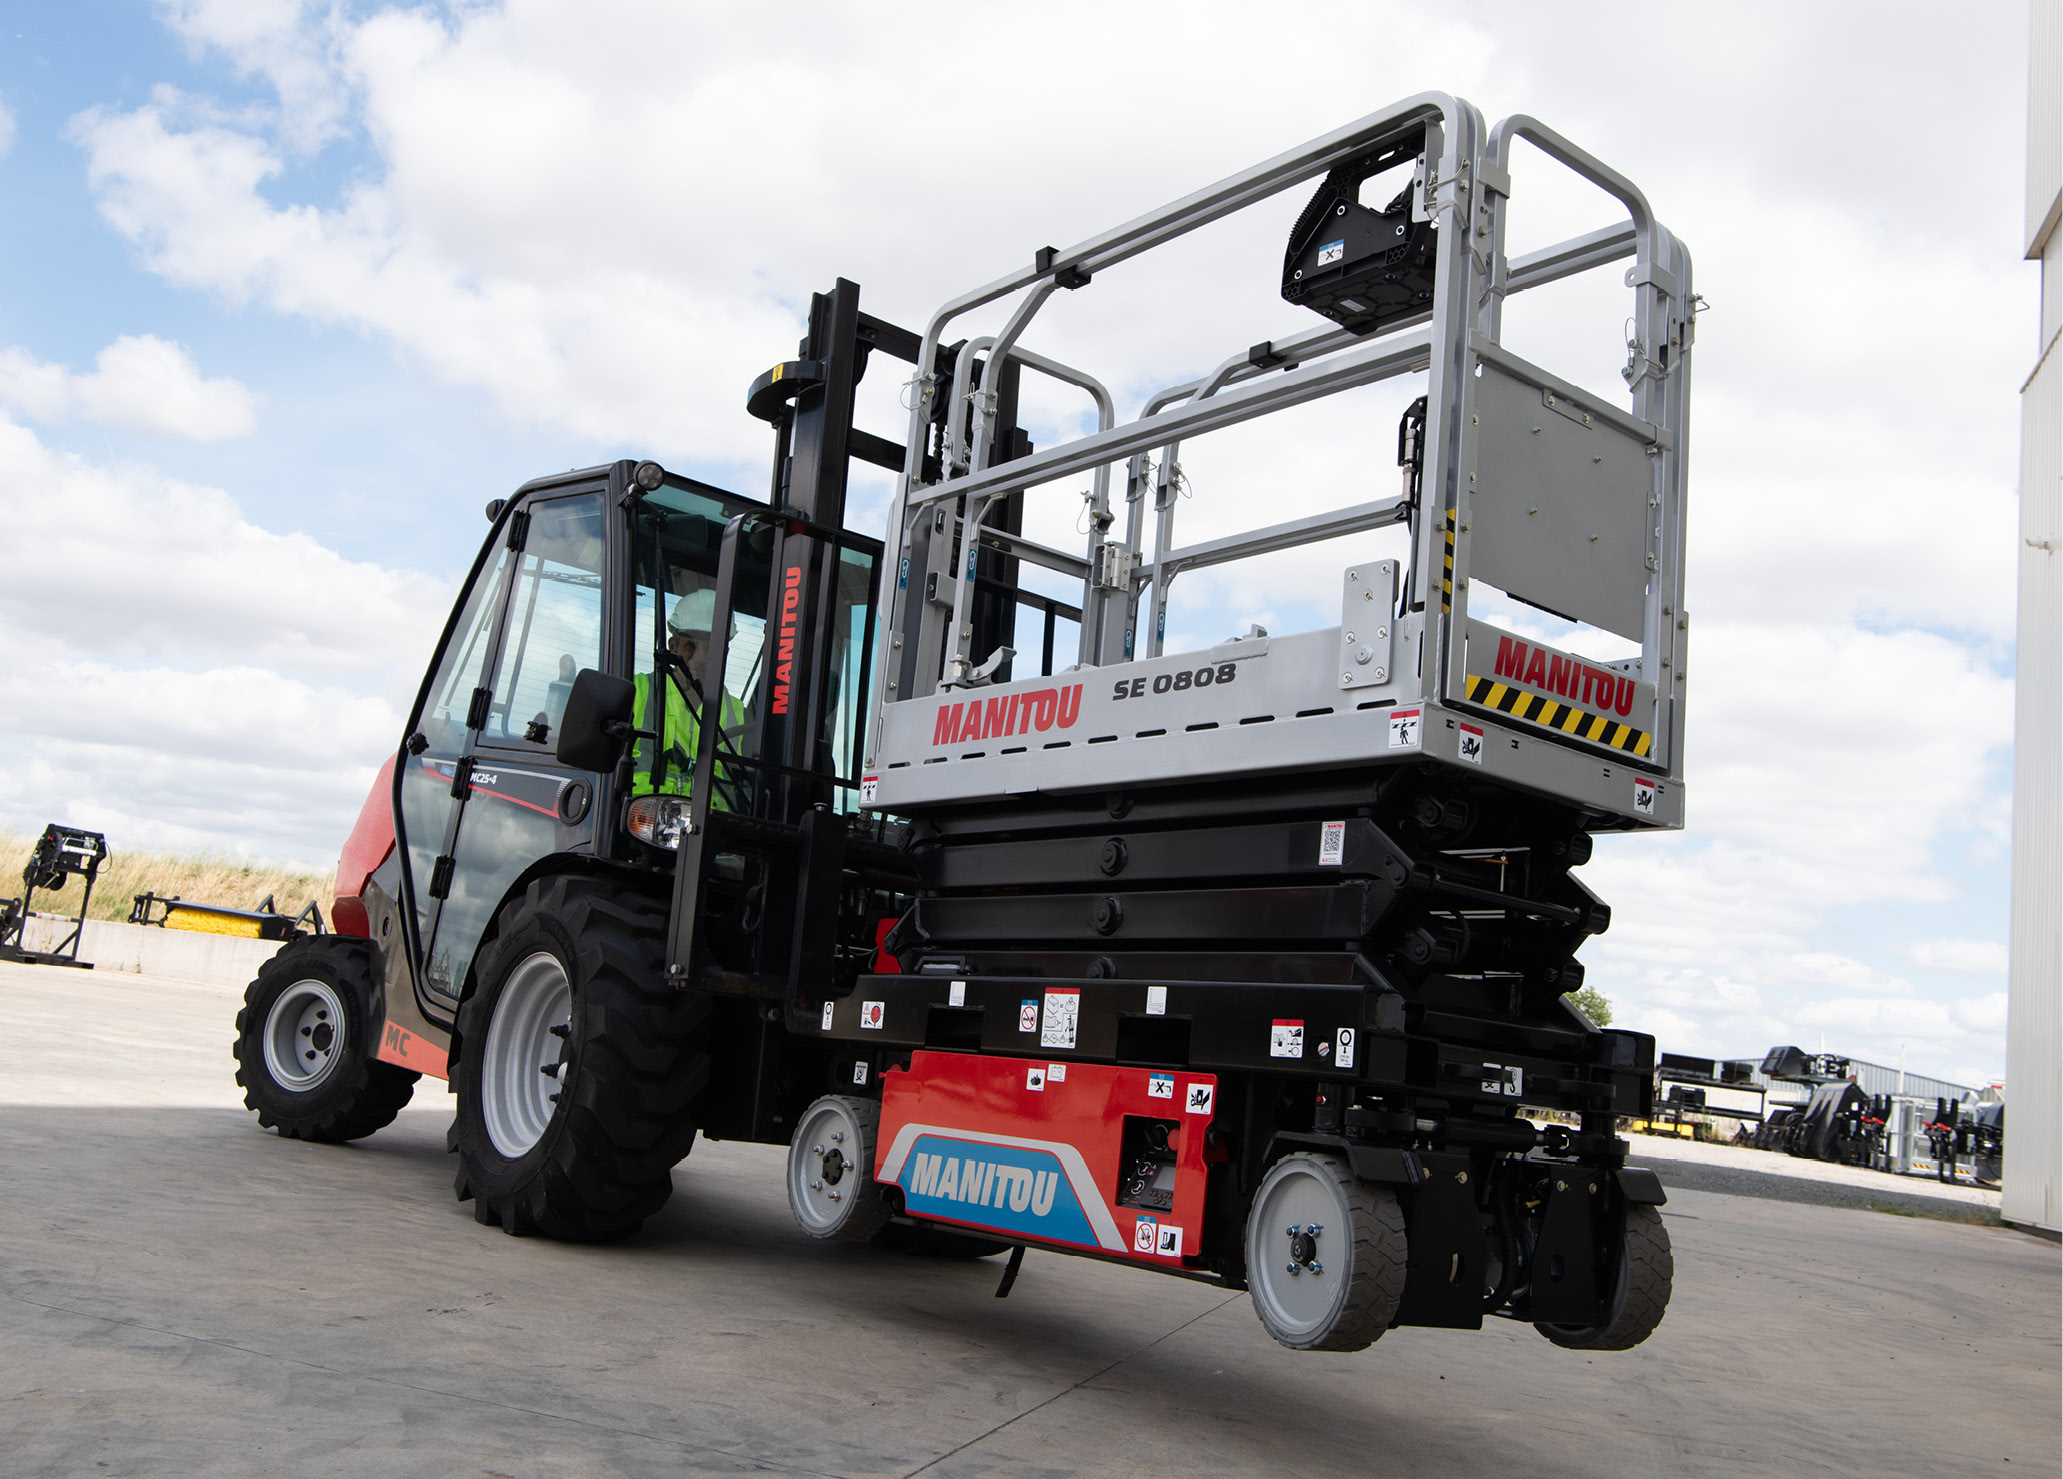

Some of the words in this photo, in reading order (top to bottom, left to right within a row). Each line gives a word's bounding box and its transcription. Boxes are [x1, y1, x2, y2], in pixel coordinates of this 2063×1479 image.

[772, 567, 801, 714] MANITOU
[1112, 677, 1147, 701] SE
[1153, 663, 1236, 695] 0808
[1494, 635, 1636, 717] MANITOU
[932, 683, 1084, 746] MANITOU
[385, 1024, 411, 1058] MC
[910, 1153, 1059, 1217] MANITOU
